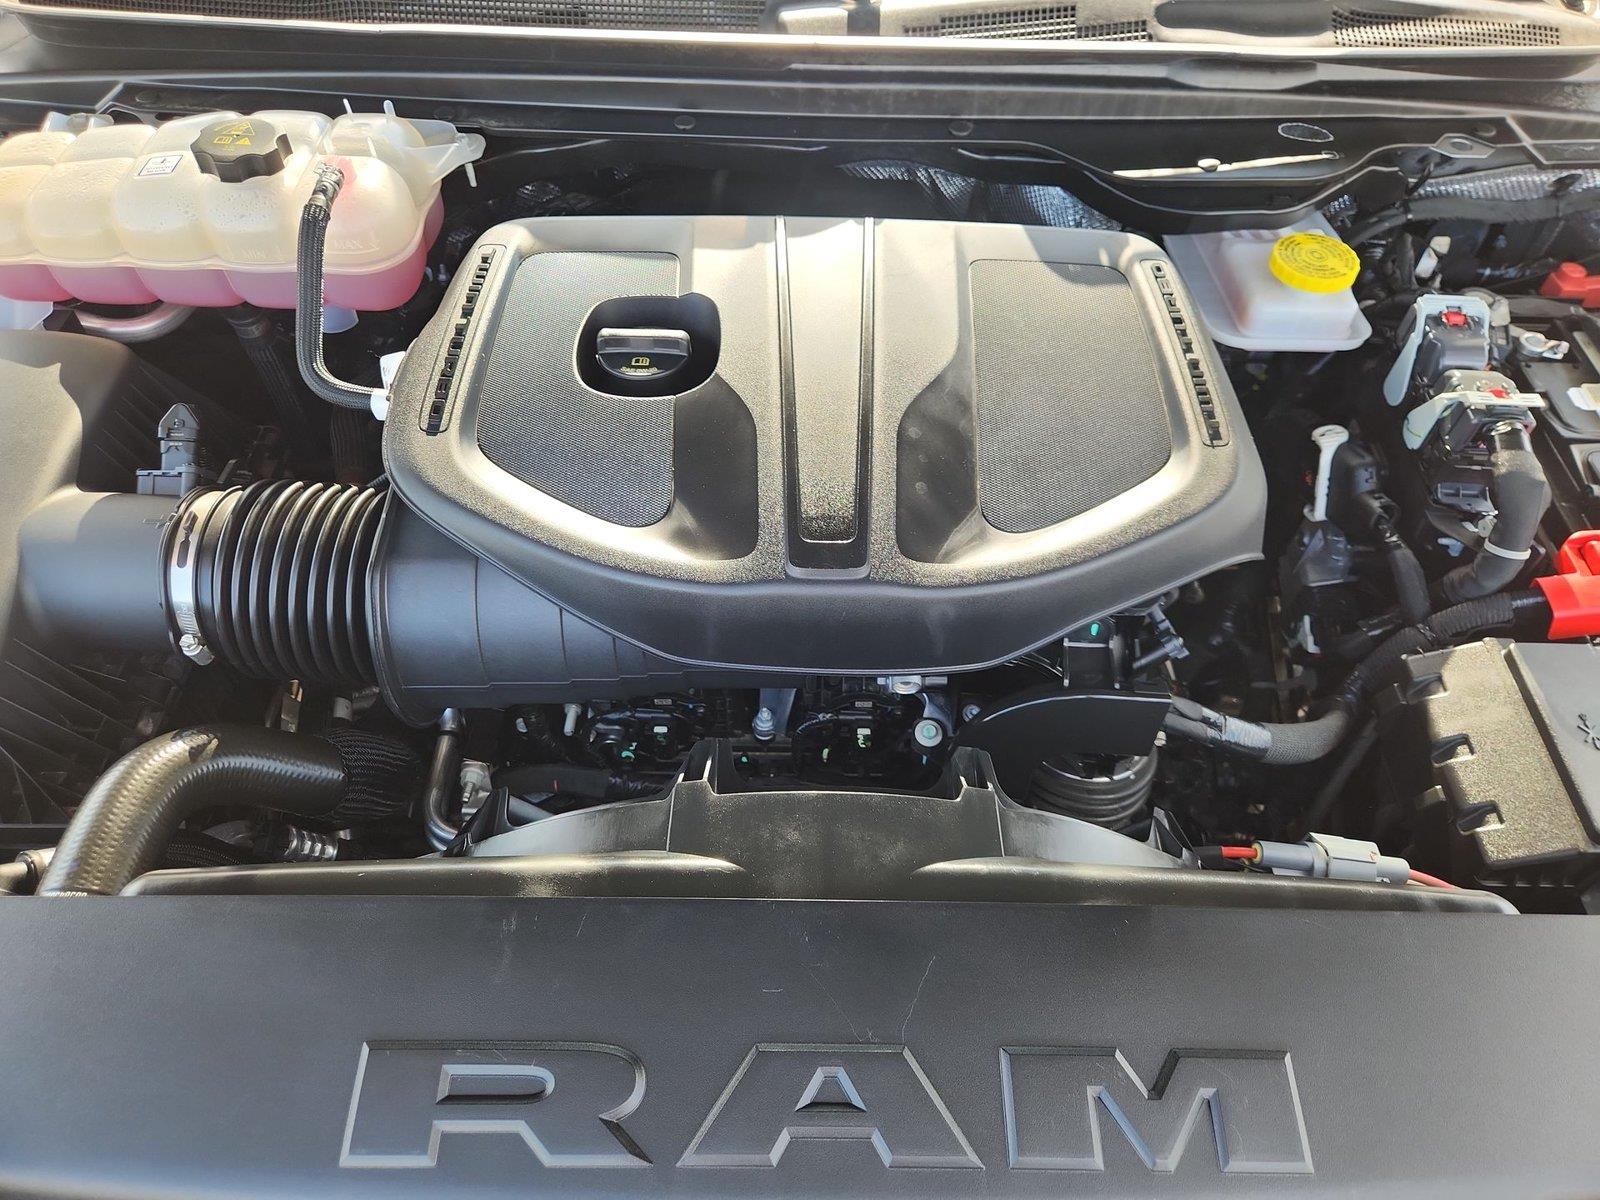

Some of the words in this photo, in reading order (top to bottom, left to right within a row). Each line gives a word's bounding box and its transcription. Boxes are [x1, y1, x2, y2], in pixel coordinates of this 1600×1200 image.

[460, 249, 496, 318] TWIN
[1151, 264, 1194, 354] TURBO
[426, 316, 471, 435] TURBO
[1186, 353, 1223, 446] TWIN
[339, 1039, 1314, 1173] RAM
